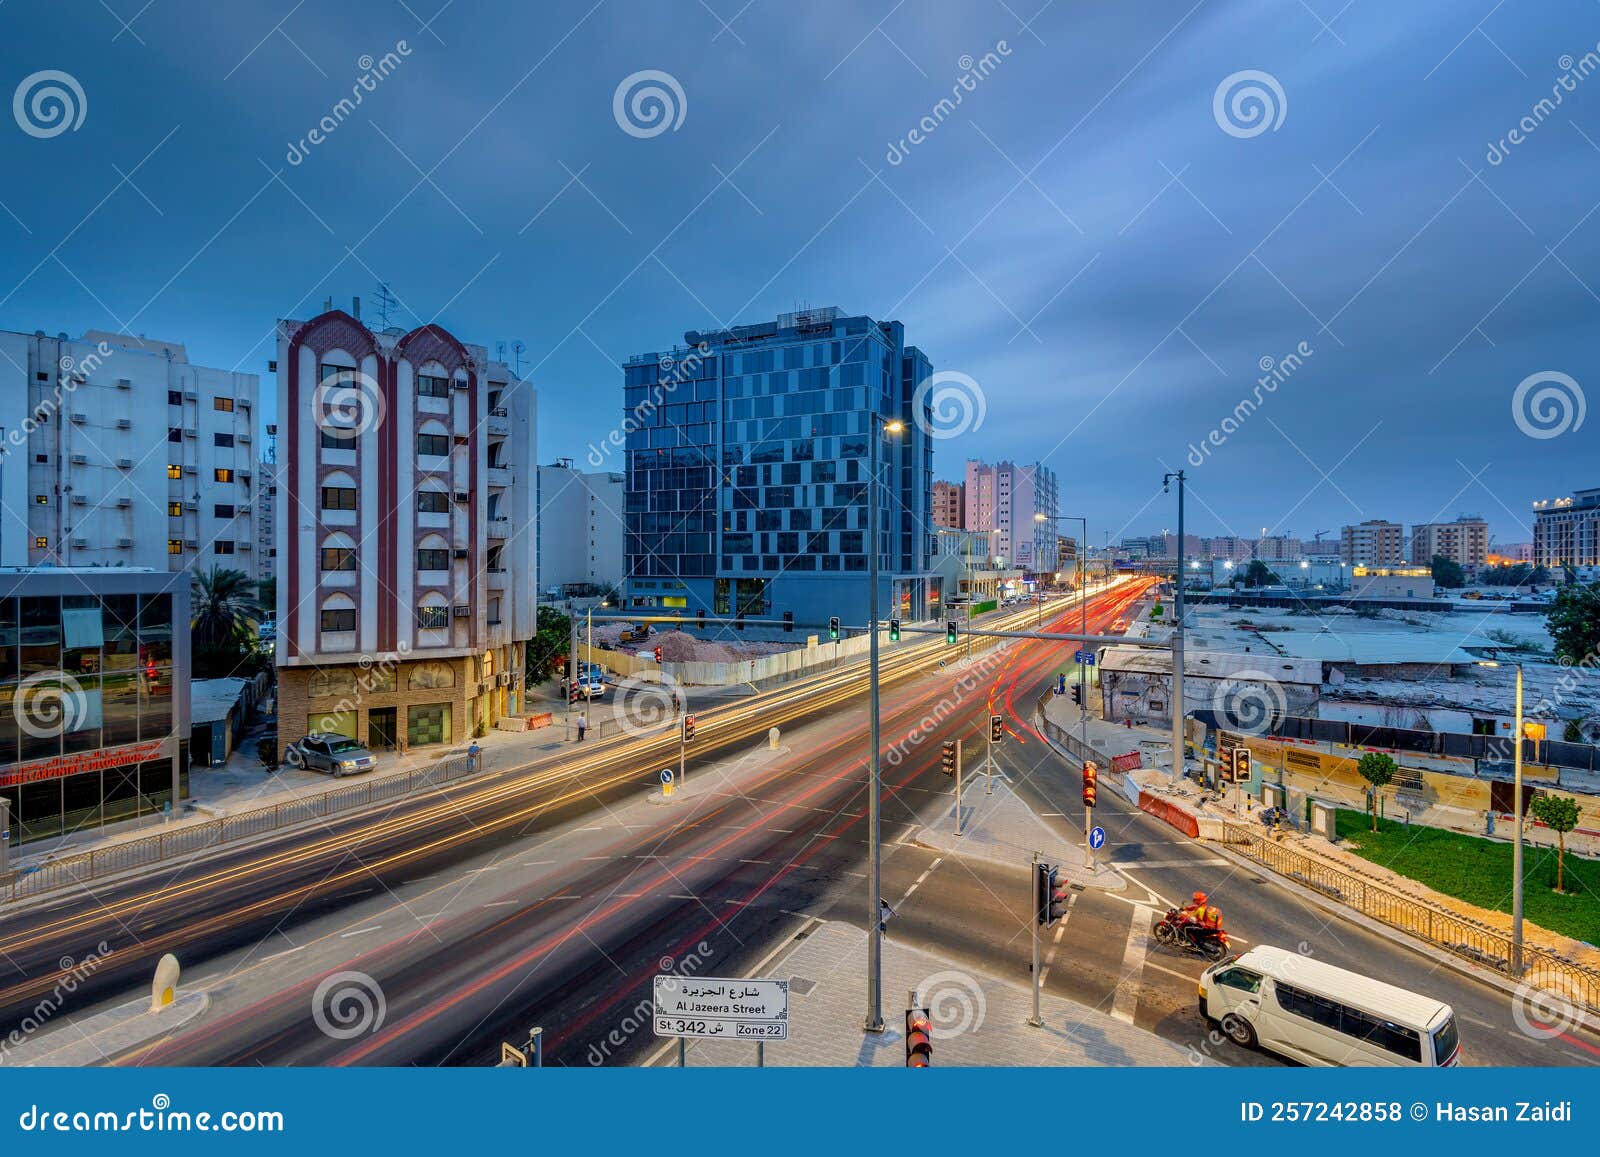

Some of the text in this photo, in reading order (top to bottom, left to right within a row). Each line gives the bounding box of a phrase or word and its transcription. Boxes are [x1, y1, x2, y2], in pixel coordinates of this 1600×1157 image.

[90, 754, 142, 771] DECORATION
[682, 985, 760, 1000] شارع الجزيرة
[676, 1001, 766, 1014] Al Jazeera Street
[676, 1020, 706, 1034] 342
[738, 1024, 781, 1035] Zone 22
